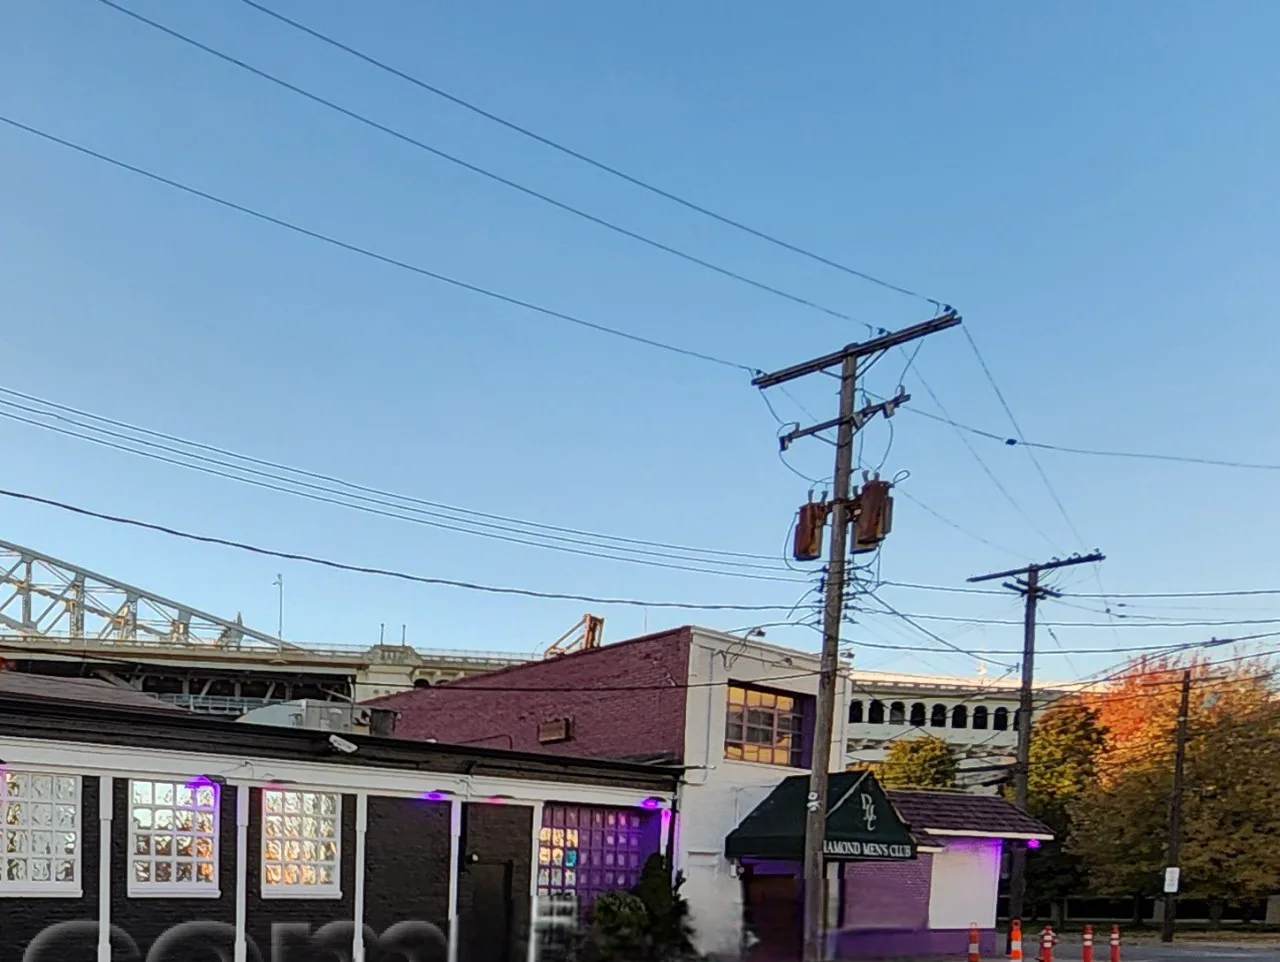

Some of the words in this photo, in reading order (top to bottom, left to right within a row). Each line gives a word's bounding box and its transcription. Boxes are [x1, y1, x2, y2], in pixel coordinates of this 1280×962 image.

[823, 840, 860, 855] IAMOND
[862, 842, 888, 856] MEN'S
[889, 845, 911, 857] CLUB
